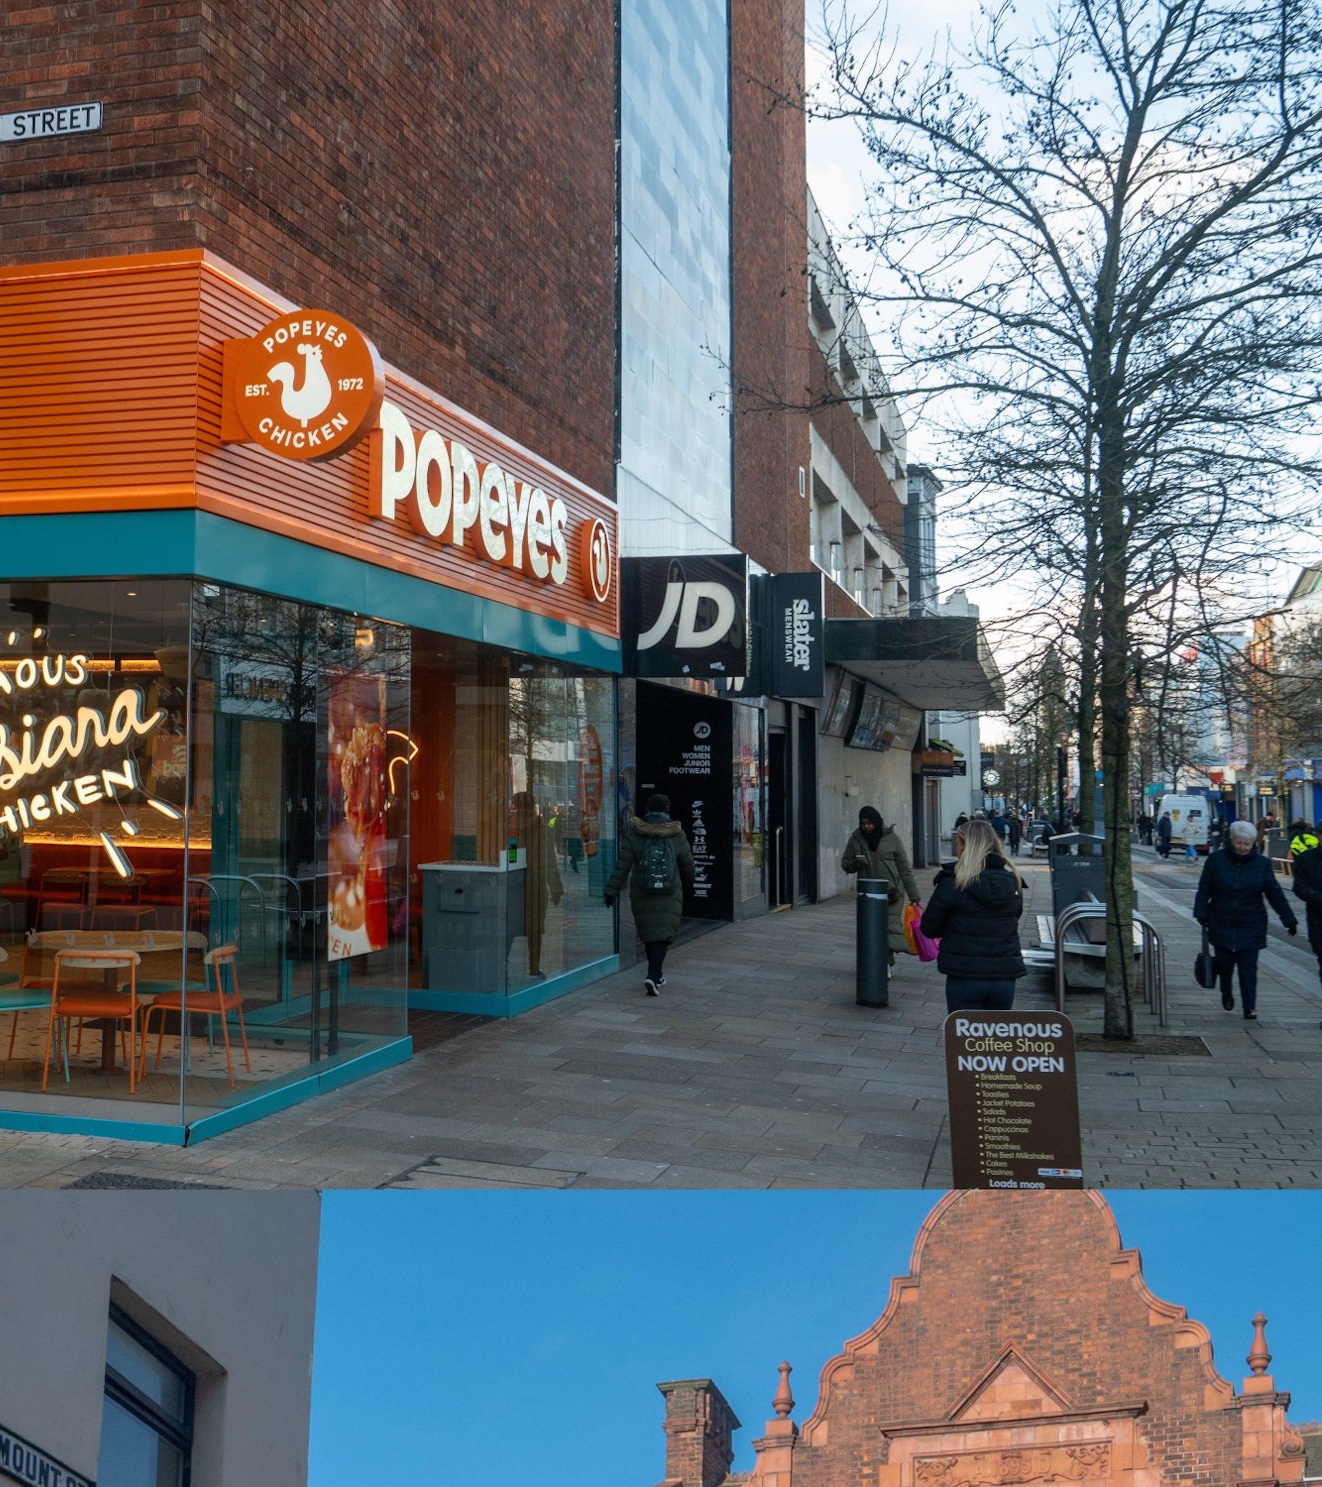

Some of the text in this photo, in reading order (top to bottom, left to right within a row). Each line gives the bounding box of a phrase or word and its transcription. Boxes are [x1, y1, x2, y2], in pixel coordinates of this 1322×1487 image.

[13, 105, 97, 137] STREET
[262, 320, 348, 354] POPEYES
[245, 377, 364, 398] EST. 1972
[258, 411, 350, 449] CHICKEN
[637, 582, 736, 650] JD
[785, 608, 794, 663] MENSWEAR
[793, 599, 816, 672] slater
[682, 752, 711, 760] WOMEN
[694, 744, 711, 752] MEN
[669, 767, 711, 775] FOOTWEAR
[956, 1018, 1063, 1038] Ravenous
[965, 1038, 1055, 1055] Coffee Shop
[958, 1055, 1065, 1073] NOW OPEN
[989, 1179, 1045, 1189] Loads more
